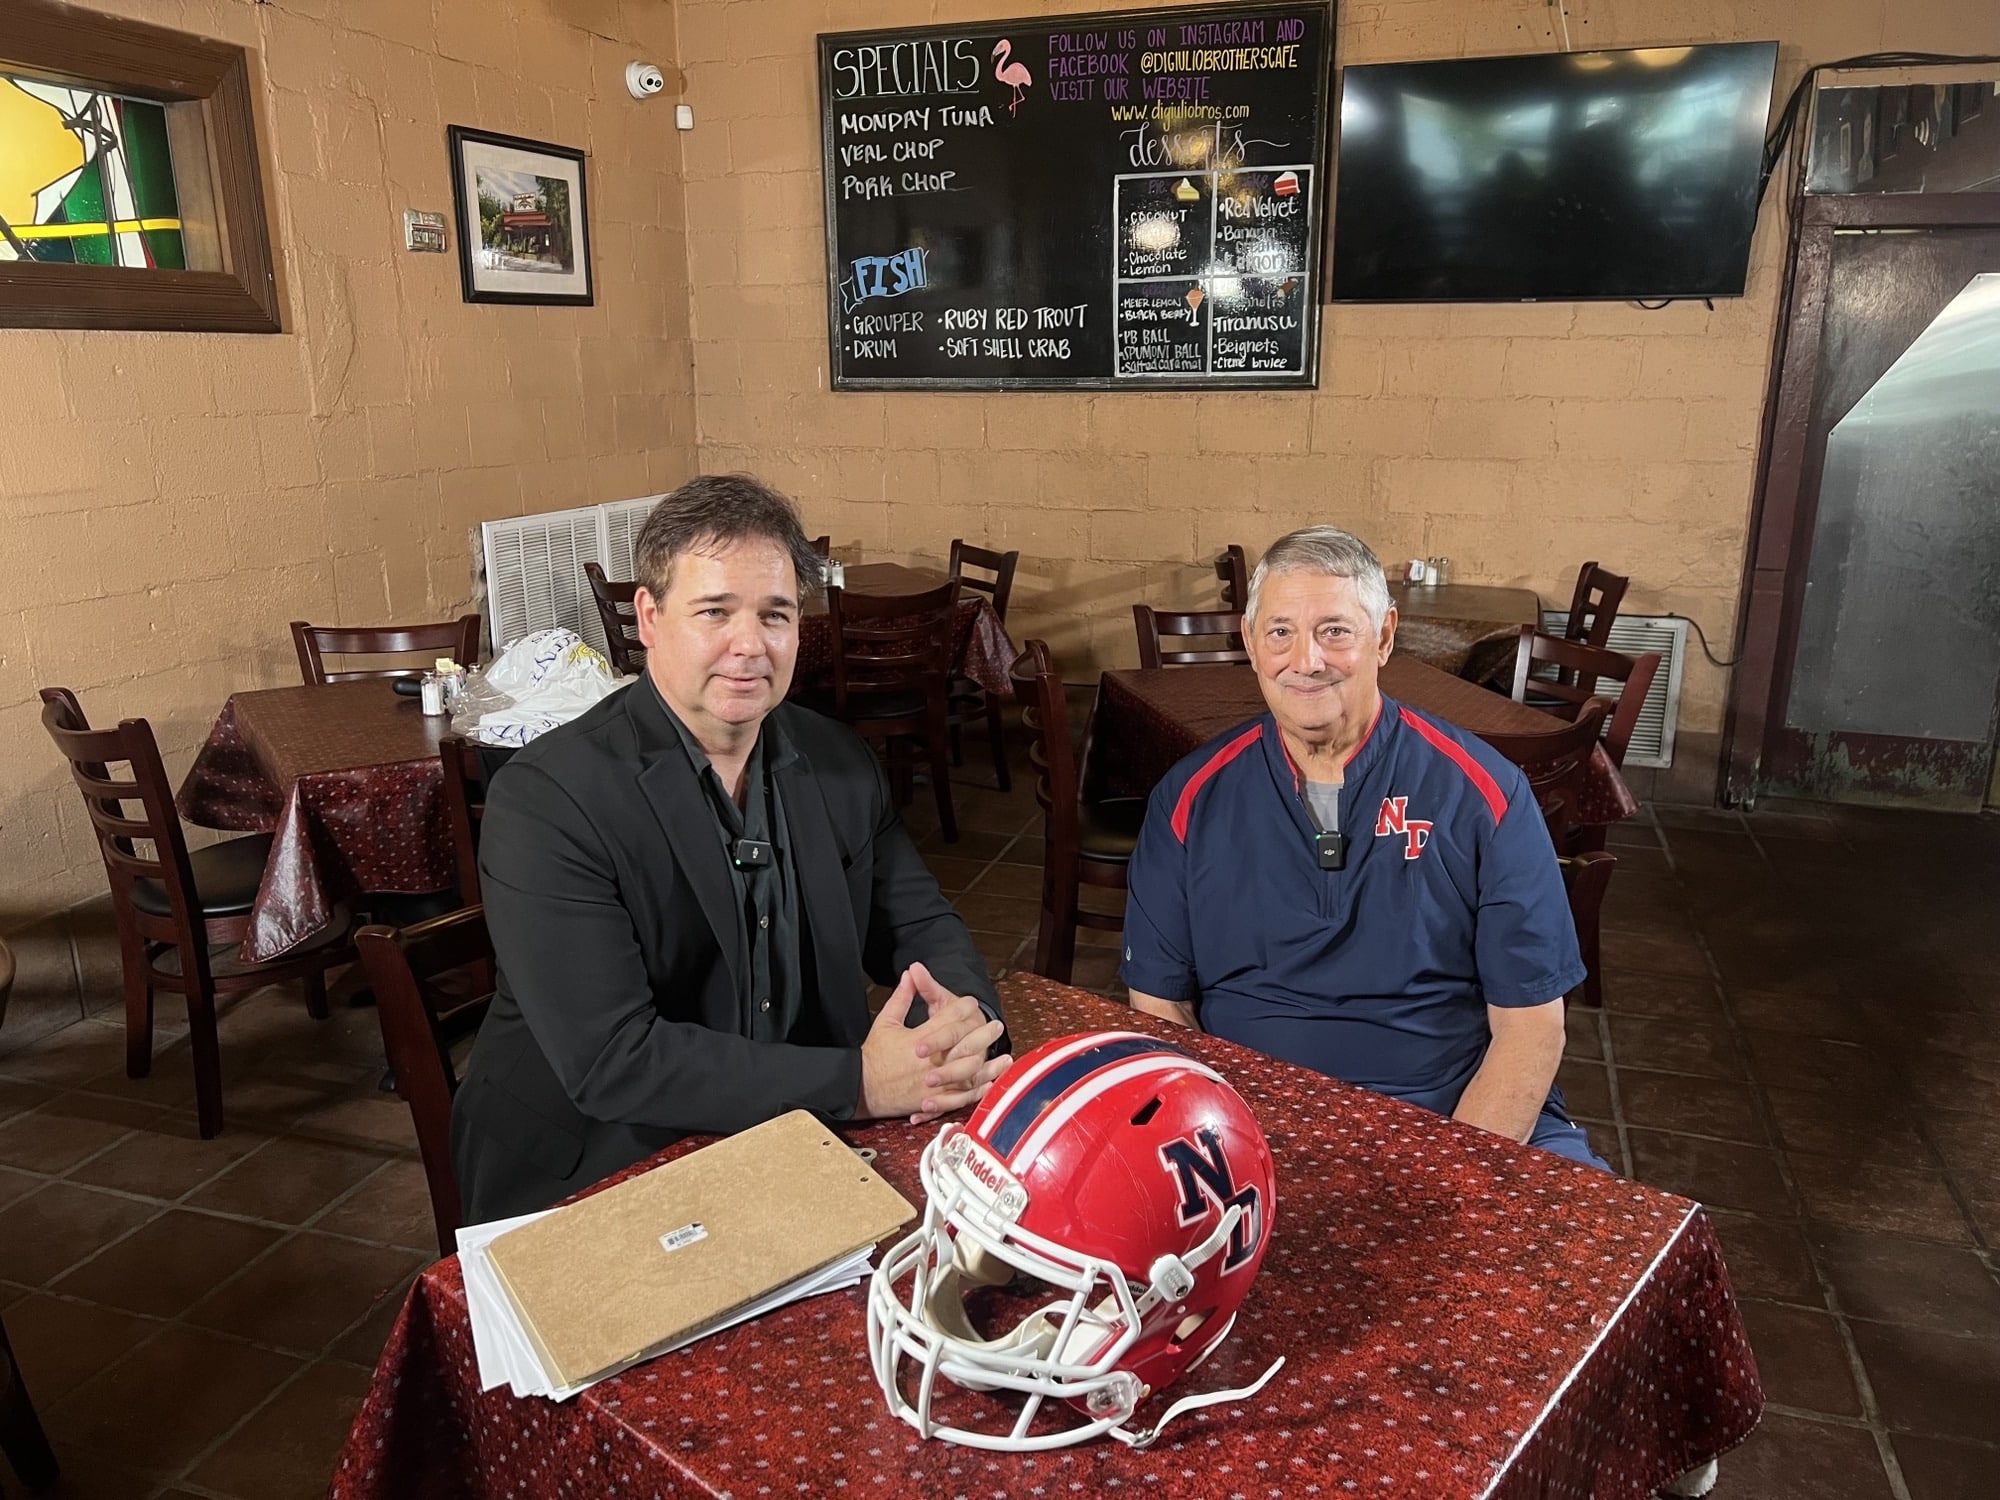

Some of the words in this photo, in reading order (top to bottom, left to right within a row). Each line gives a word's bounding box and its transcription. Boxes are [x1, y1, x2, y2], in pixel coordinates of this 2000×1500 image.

[1049, 33, 1108, 54] FOLLOW
[1118, 30, 1136, 49] US
[1147, 28, 1166, 48] ON
[1179, 20, 1265, 46] INSTAGRAM
[1276, 19, 1305, 44] AND
[833, 39, 979, 97] SPECIALS
[1049, 54, 1130, 78] FACEBOOK
[1140, 45, 1300, 75] @DIGIULIOBROTHERSCAFE
[1050, 79, 1095, 101] VISIT
[1104, 78, 1129, 100] OUR
[1142, 76, 1211, 100] WEBSITE
[840, 107, 931, 135] MONDAY
[938, 105, 994, 127] TUNA
[841, 143, 887, 167] VEAL
[893, 139, 944, 162] CHOP
[843, 175, 893, 200] PORK
[902, 171, 956, 192] CHOP
[1253, 196, 1298, 217] Velvet
[1129, 249, 1187, 265] Chocolate
[1130, 263, 1171, 276] Lemon
[855, 249, 924, 298] FISH
[1151, 297, 1182, 308] LEMON
[853, 311, 924, 336] GROUPER
[944, 308, 988, 331] RUBY
[996, 307, 1028, 331] RED
[1032, 304, 1088, 331] TROUT
[1125, 309, 1158, 322] BLACK
[854, 338, 898, 359] DRUM
[947, 336, 979, 358] SOFT
[982, 338, 1023, 359] SHELL
[1028, 338, 1071, 360] CRAB
[1143, 328, 1171, 345] BALL
[1218, 337, 1279, 360] Beignets
[1123, 345, 1170, 361] SPUMONI
[1174, 343, 1202, 359] BALL
[1375, 795, 1434, 860] ND
